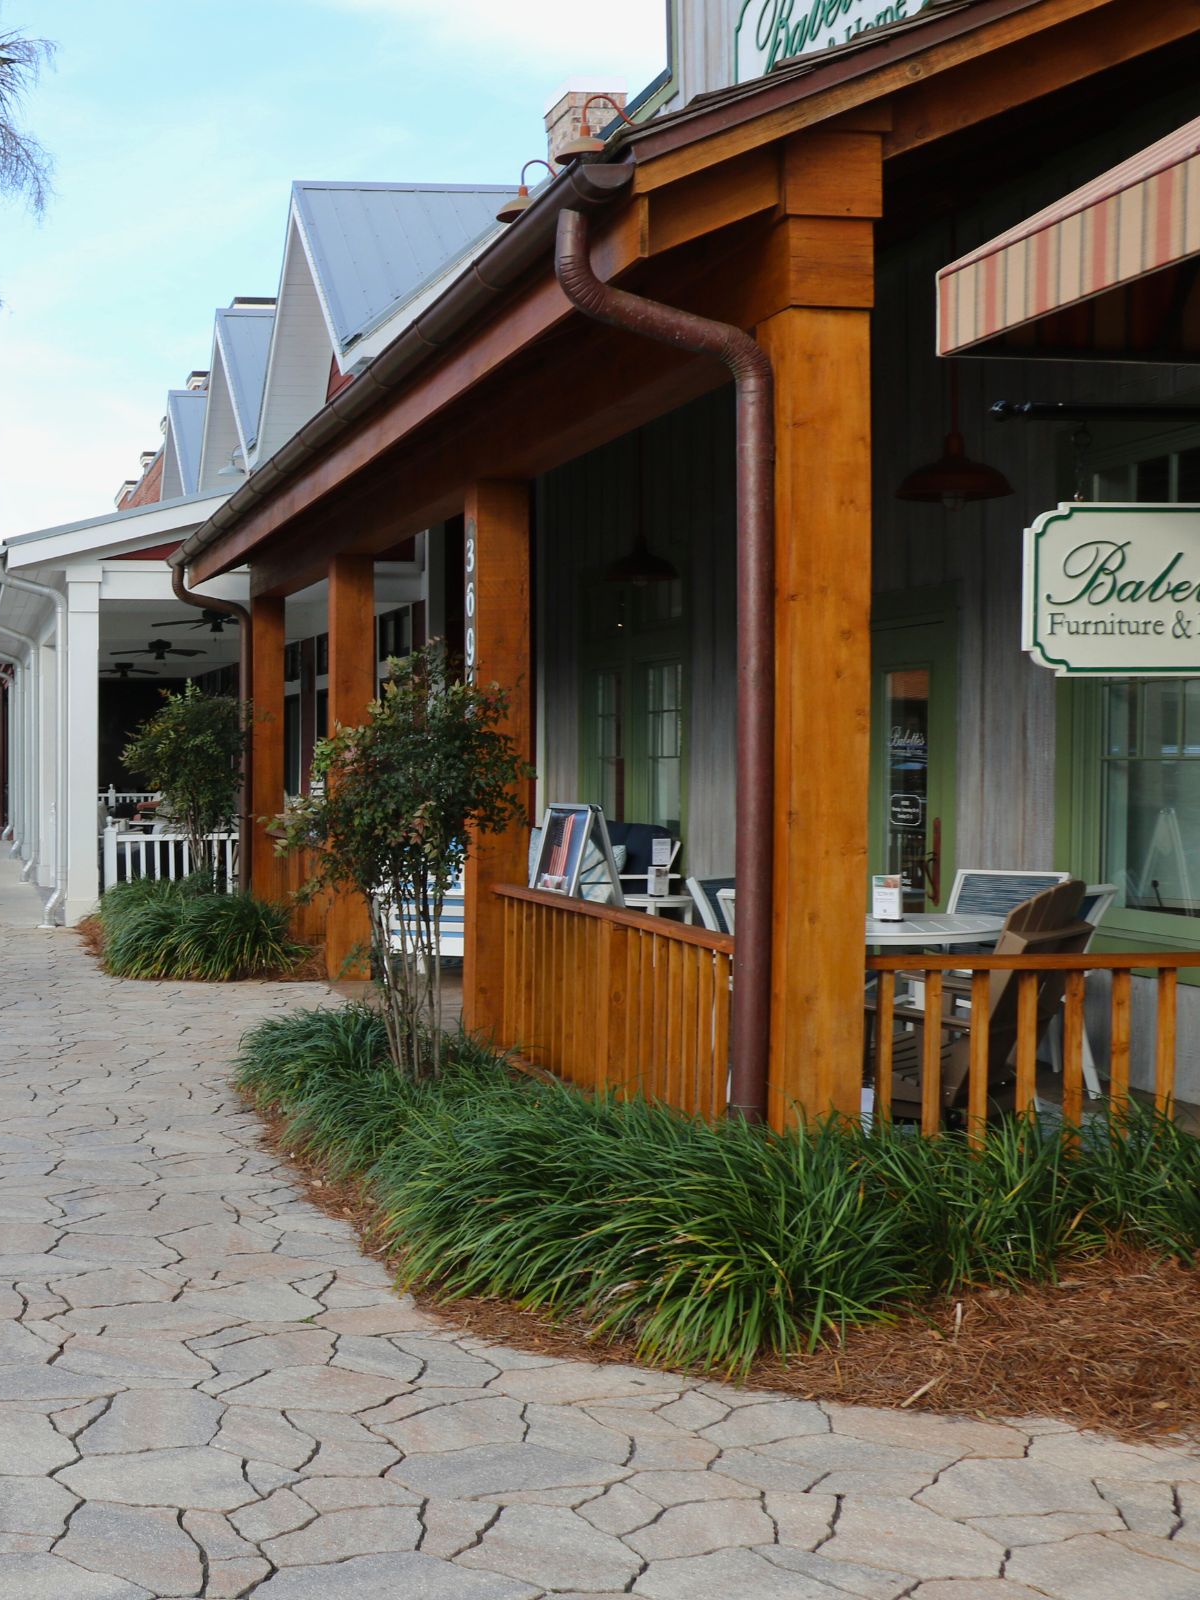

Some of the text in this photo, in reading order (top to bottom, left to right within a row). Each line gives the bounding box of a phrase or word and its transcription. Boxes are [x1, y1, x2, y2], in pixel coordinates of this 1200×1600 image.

[1046, 540, 1200, 605] Babe
[1047, 612, 1165, 636] Furniture
[1171, 610, 1192, 639] &
